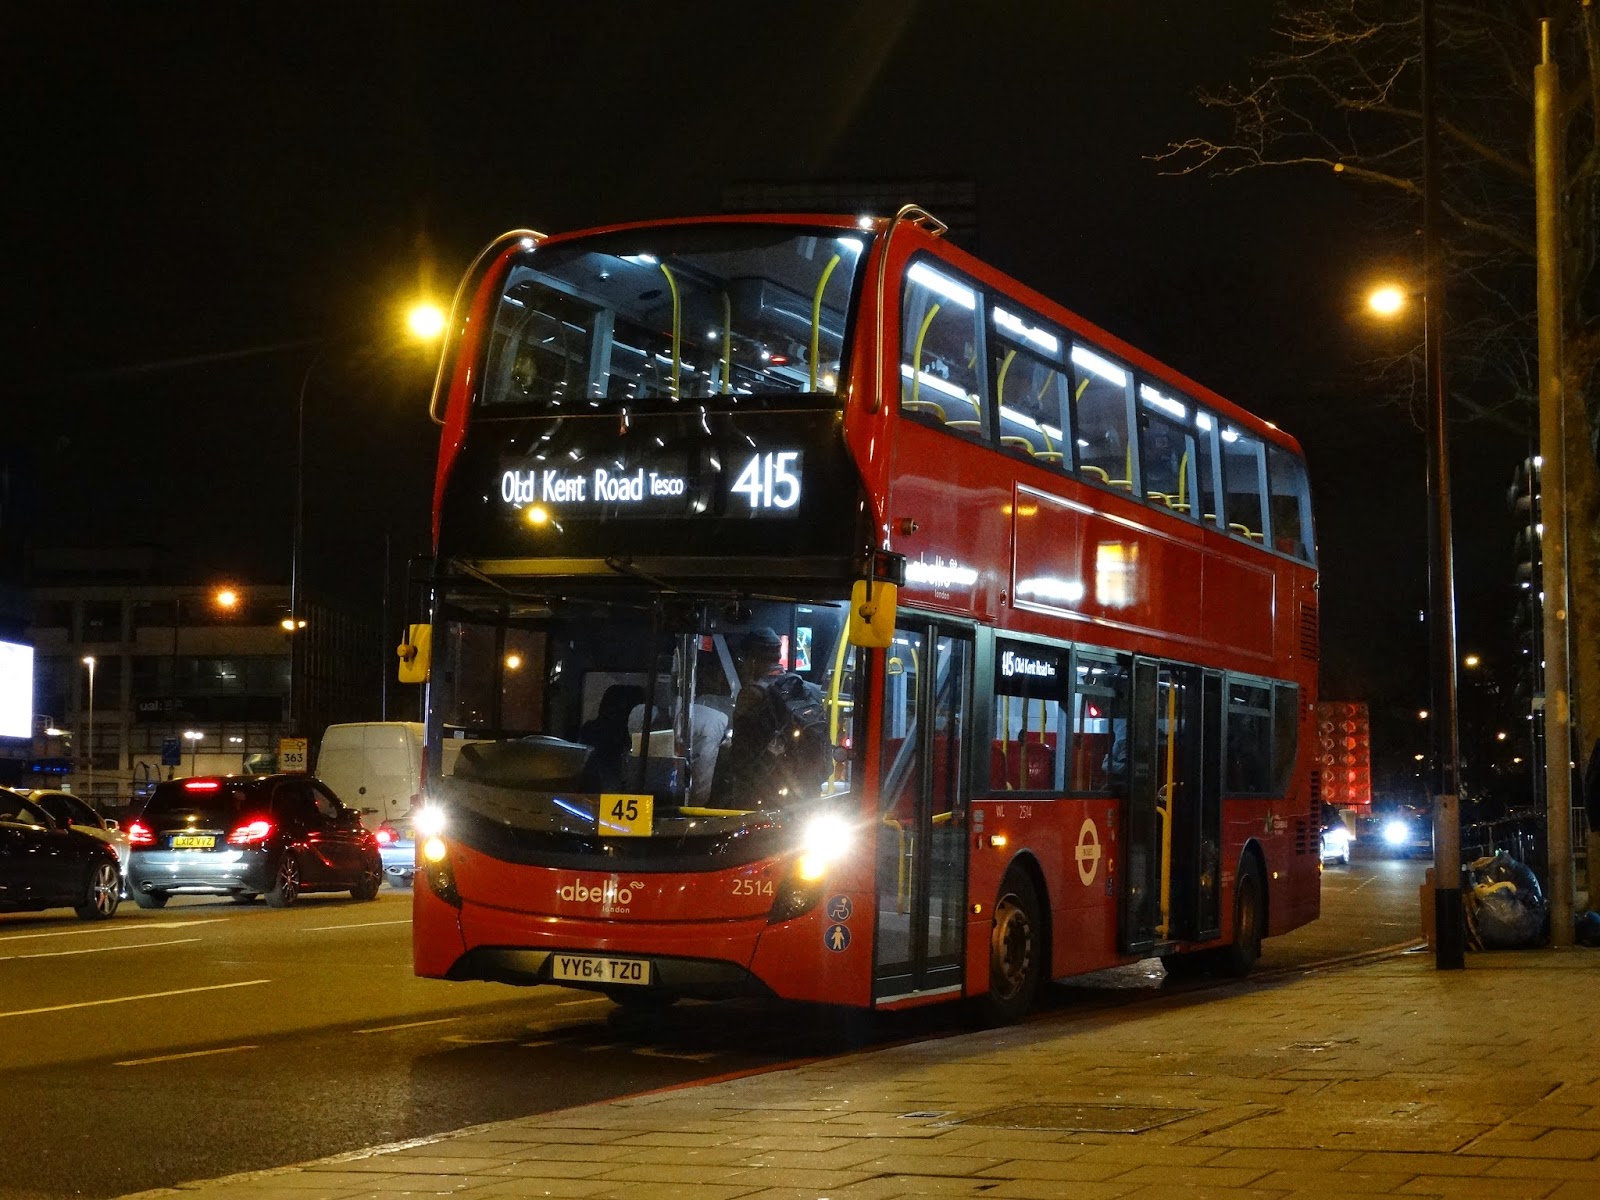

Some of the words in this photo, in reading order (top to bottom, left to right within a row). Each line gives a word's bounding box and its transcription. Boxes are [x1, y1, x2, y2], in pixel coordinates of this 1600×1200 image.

[501, 470, 533, 503] Old
[543, 470, 586, 502] Kent
[595, 468, 643, 501] Road
[650, 472, 683, 496] Tesco
[731, 451, 801, 508] 415
[284, 753, 303, 763] 363
[611, 799, 638, 822] 45
[1019, 805, 1032, 819] 2514
[561, 878, 632, 904] abellio
[732, 879, 774, 896] 2514
[602, 905, 630, 914] london
[561, 958, 603, 978] YY64
[609, 961, 642, 980] TZO
